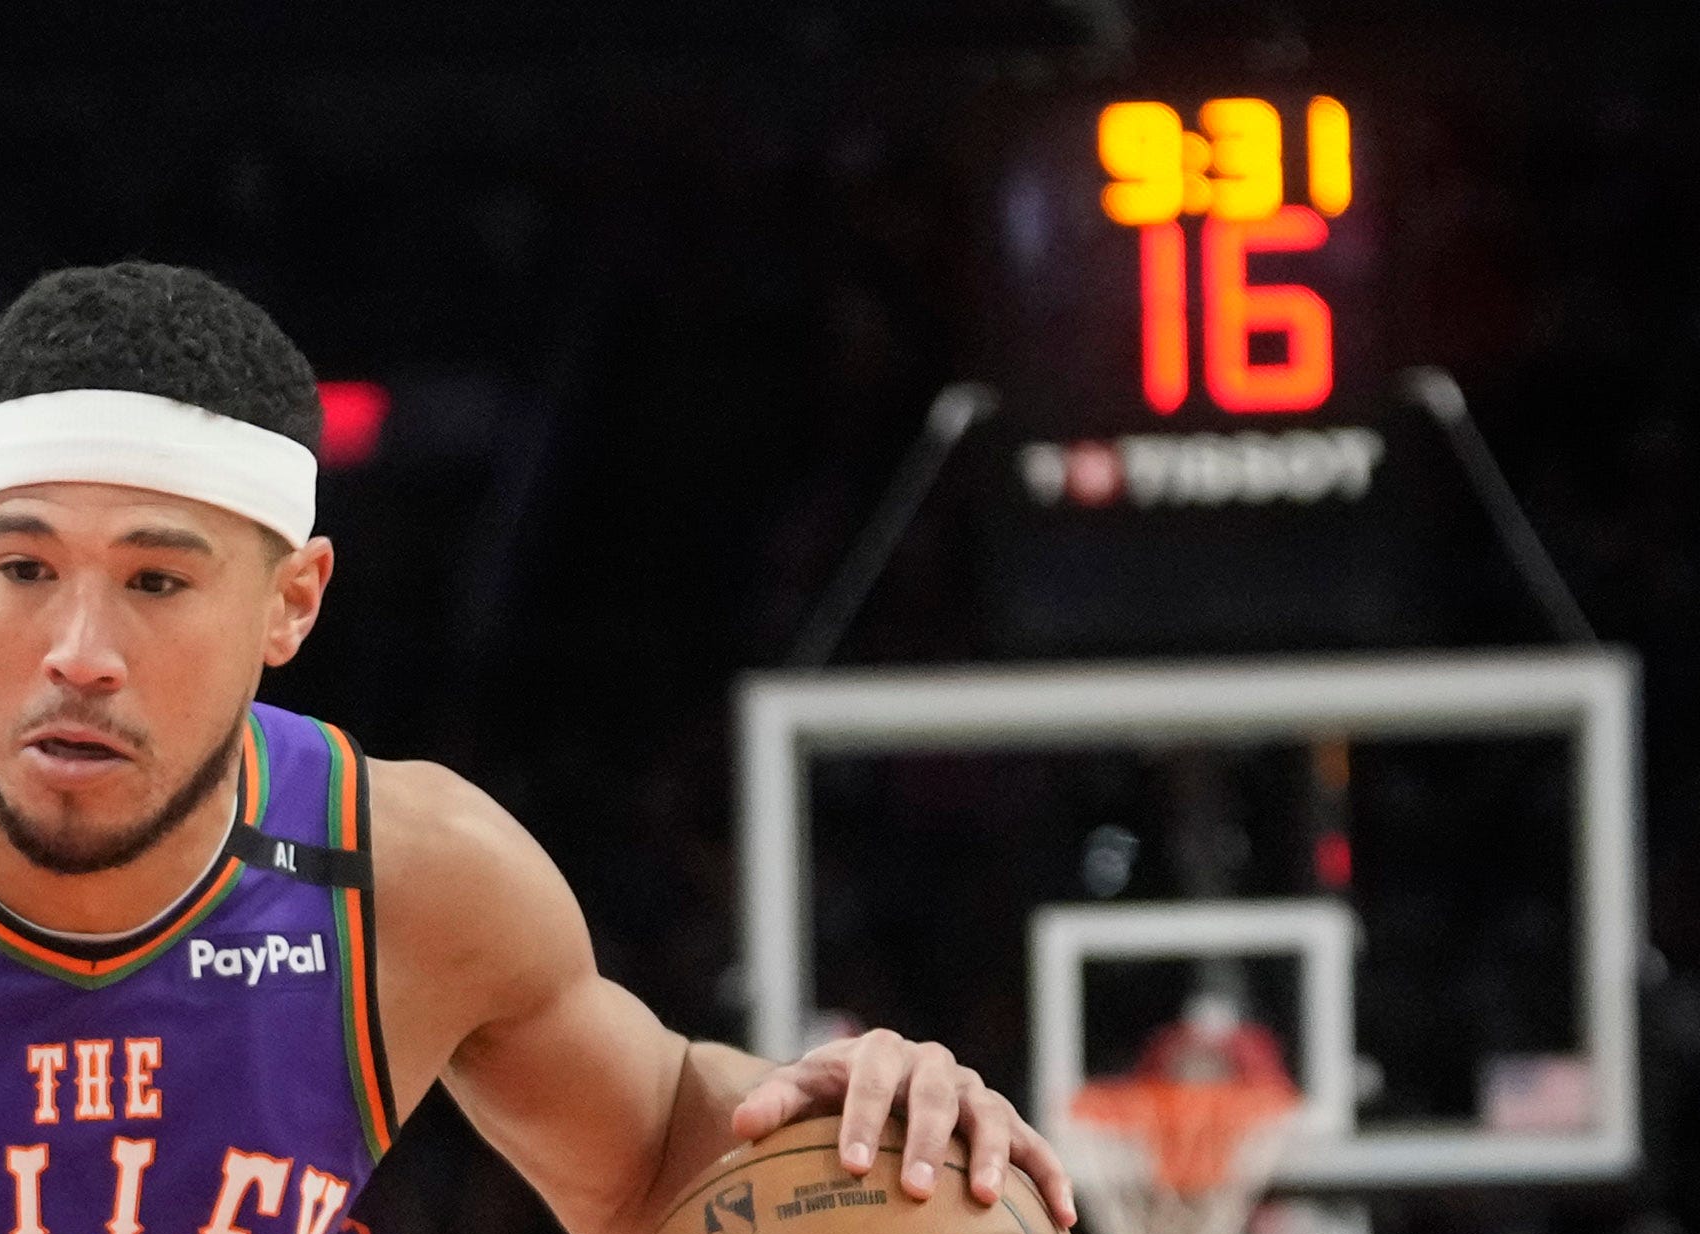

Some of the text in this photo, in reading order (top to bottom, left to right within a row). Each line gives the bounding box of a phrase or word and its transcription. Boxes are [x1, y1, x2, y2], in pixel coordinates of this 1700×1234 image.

[1098, 94, 1353, 226] 9:31
[1139, 203, 1335, 415] 16
[274, 840, 298, 873] AL
[188, 932, 327, 987] PayPal
[26, 1036, 163, 1125] THE
